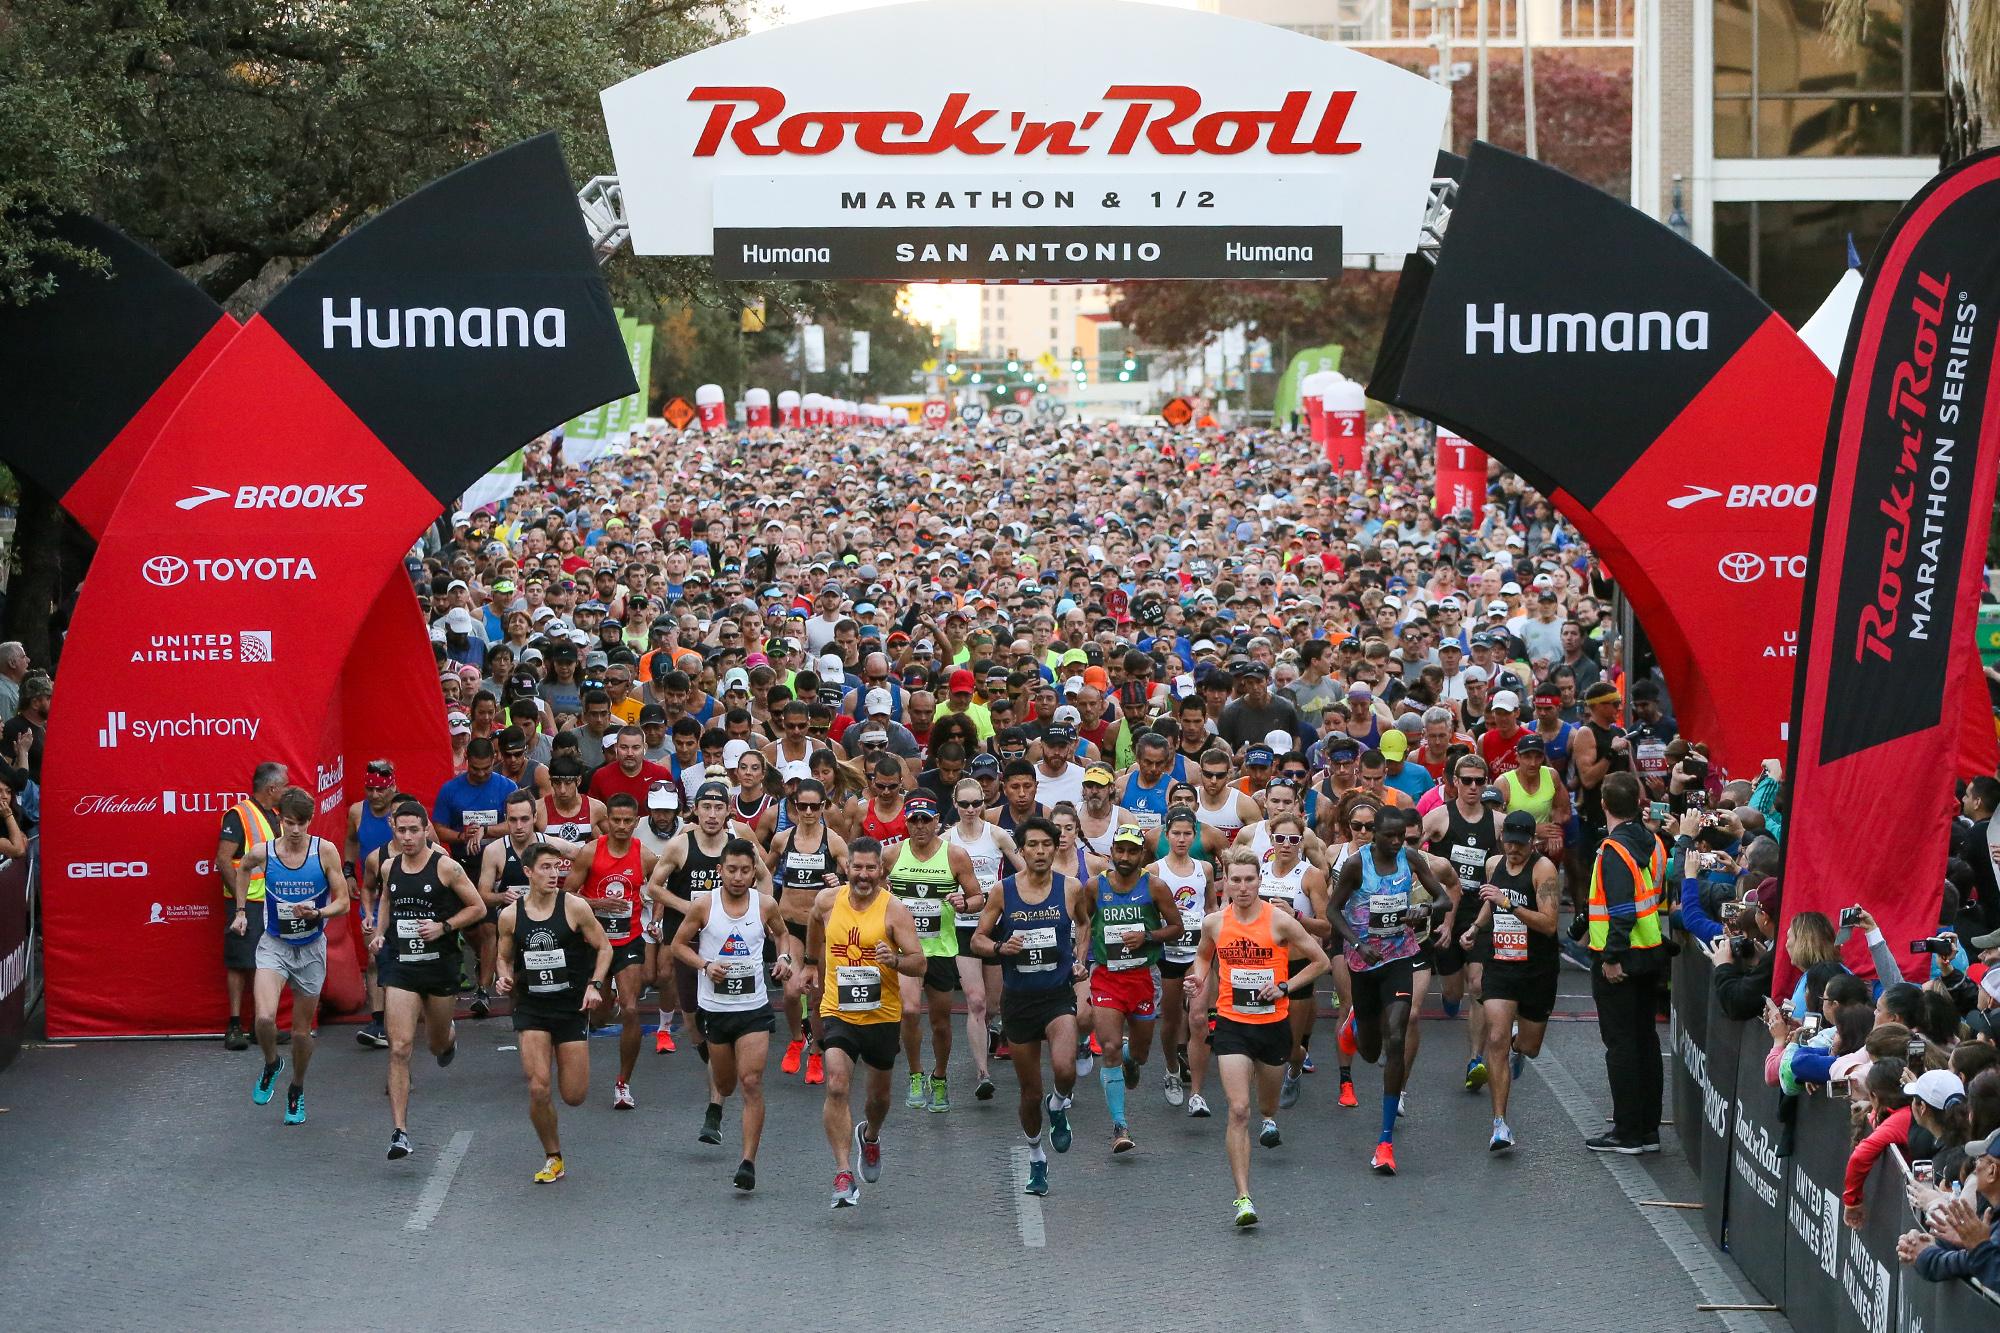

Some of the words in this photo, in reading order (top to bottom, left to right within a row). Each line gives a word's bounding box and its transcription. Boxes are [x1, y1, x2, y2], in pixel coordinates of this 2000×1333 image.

[842, 191, 1073, 209] MARATHON
[1102, 190, 1121, 209] &
[743, 245, 830, 264] Humana
[896, 244, 968, 262] SAN
[988, 242, 1161, 262] ANTONIO
[1226, 243, 1313, 262] Humana
[322, 297, 566, 349] Humana
[1466, 302, 1709, 355] Humana
[705, 408, 714, 420] 5
[925, 404, 946, 416] 05
[1342, 419, 1354, 437] 2
[1455, 447, 1465, 470] 1
[234, 484, 368, 509] BROOKS
[1909, 438, 1954, 640] MARATHON
[193, 557, 316, 582] TOYOTA
[1142, 604, 1162, 620] 3:15
[151, 634, 233, 647] UNITED
[131, 649, 233, 663] AIRLINES
[132, 712, 261, 743] synchrony
[1640, 759, 1663, 768] 1825
[74, 794, 158, 815] Michelob
[67, 861, 148, 879] GEICO
[797, 870, 813, 880] 87
[1459, 865, 1474, 876] 68
[275, 887, 315, 896] NELSON
[1103, 907, 1145, 922] BRASIL
[1381, 914, 1398, 924] 66
[290, 919, 307, 931] 54
[609, 919, 617, 929] 3
[409, 939, 425, 950] 63
[1493, 933, 1527, 945] 10038
[1029, 949, 1042, 960] 51
[539, 970, 554, 981] 61
[727, 980, 743, 990] 52
[851, 986, 869, 997] 65
[1249, 990, 1255, 1001] 1
[1796, 1164, 1823, 1217] UNITED
[1788, 1196, 1821, 1256] AIRLINES
[1850, 1228, 1875, 1290] UNITED
[1842, 1258, 1871, 1332] AIRLINES
